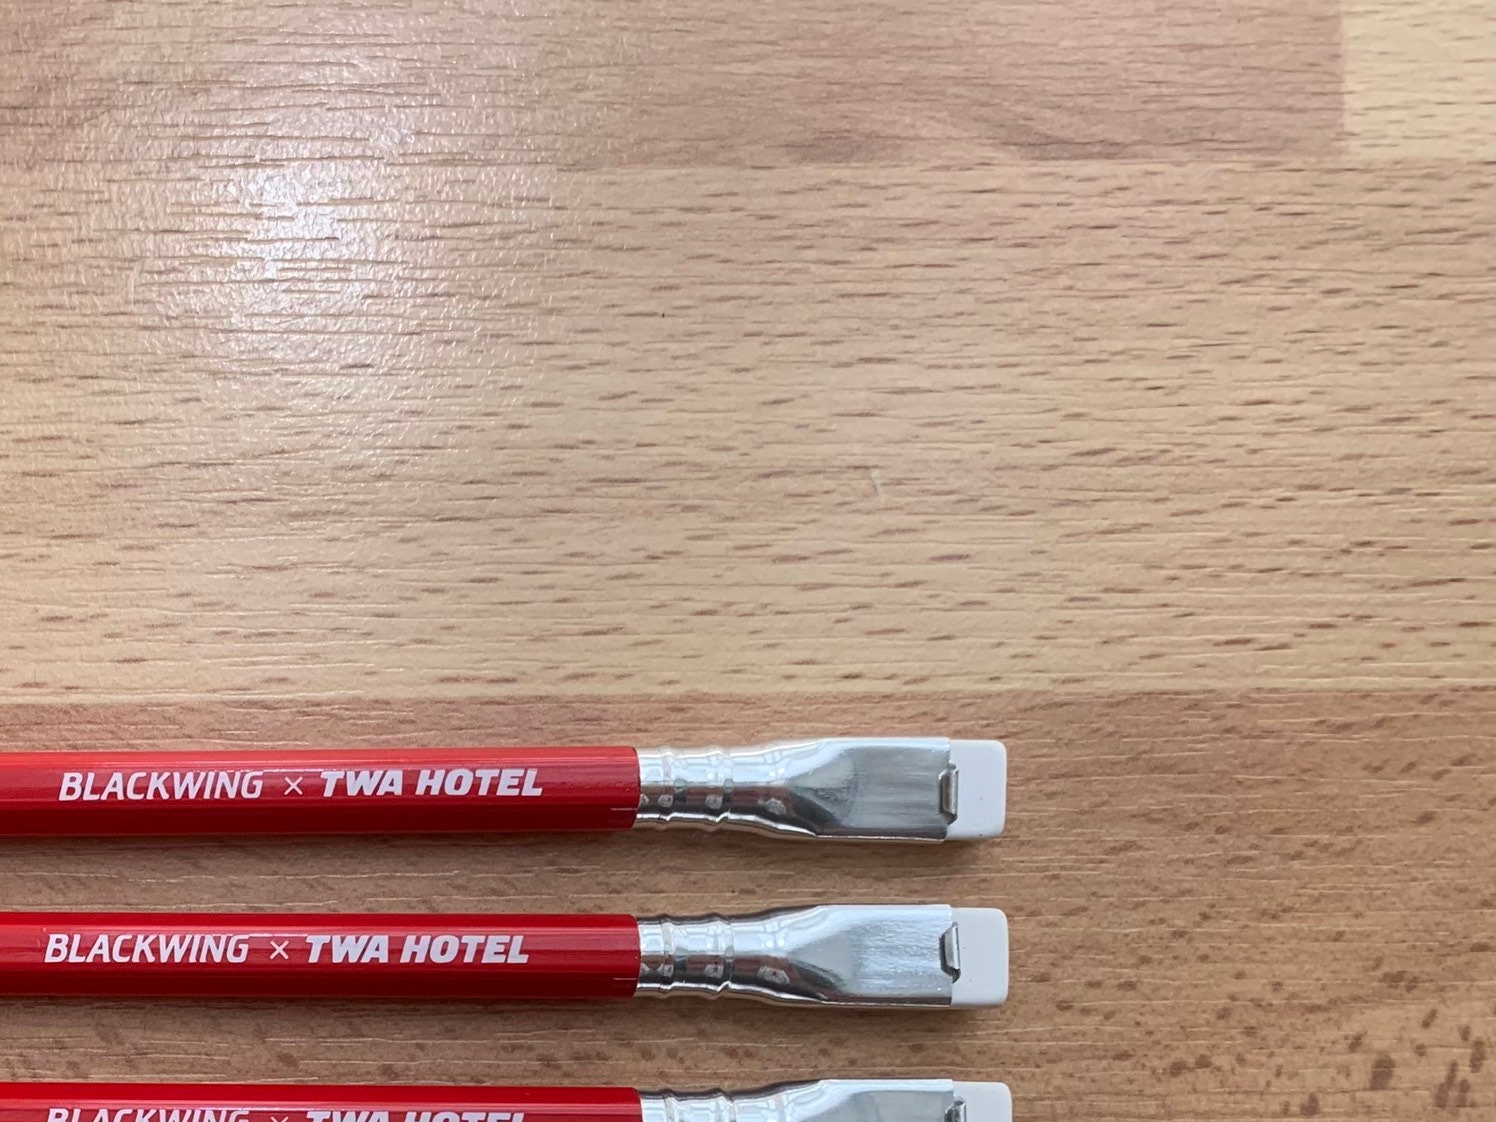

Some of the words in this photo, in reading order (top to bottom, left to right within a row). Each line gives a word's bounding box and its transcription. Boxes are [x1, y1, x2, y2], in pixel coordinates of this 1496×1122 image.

[57, 768, 265, 802] BLACKWING
[320, 767, 404, 797] TWA
[415, 767, 544, 797] HOTEL
[43, 931, 251, 964] BLACKWING
[306, 934, 389, 964] TWA
[399, 933, 530, 964] HOTEL
